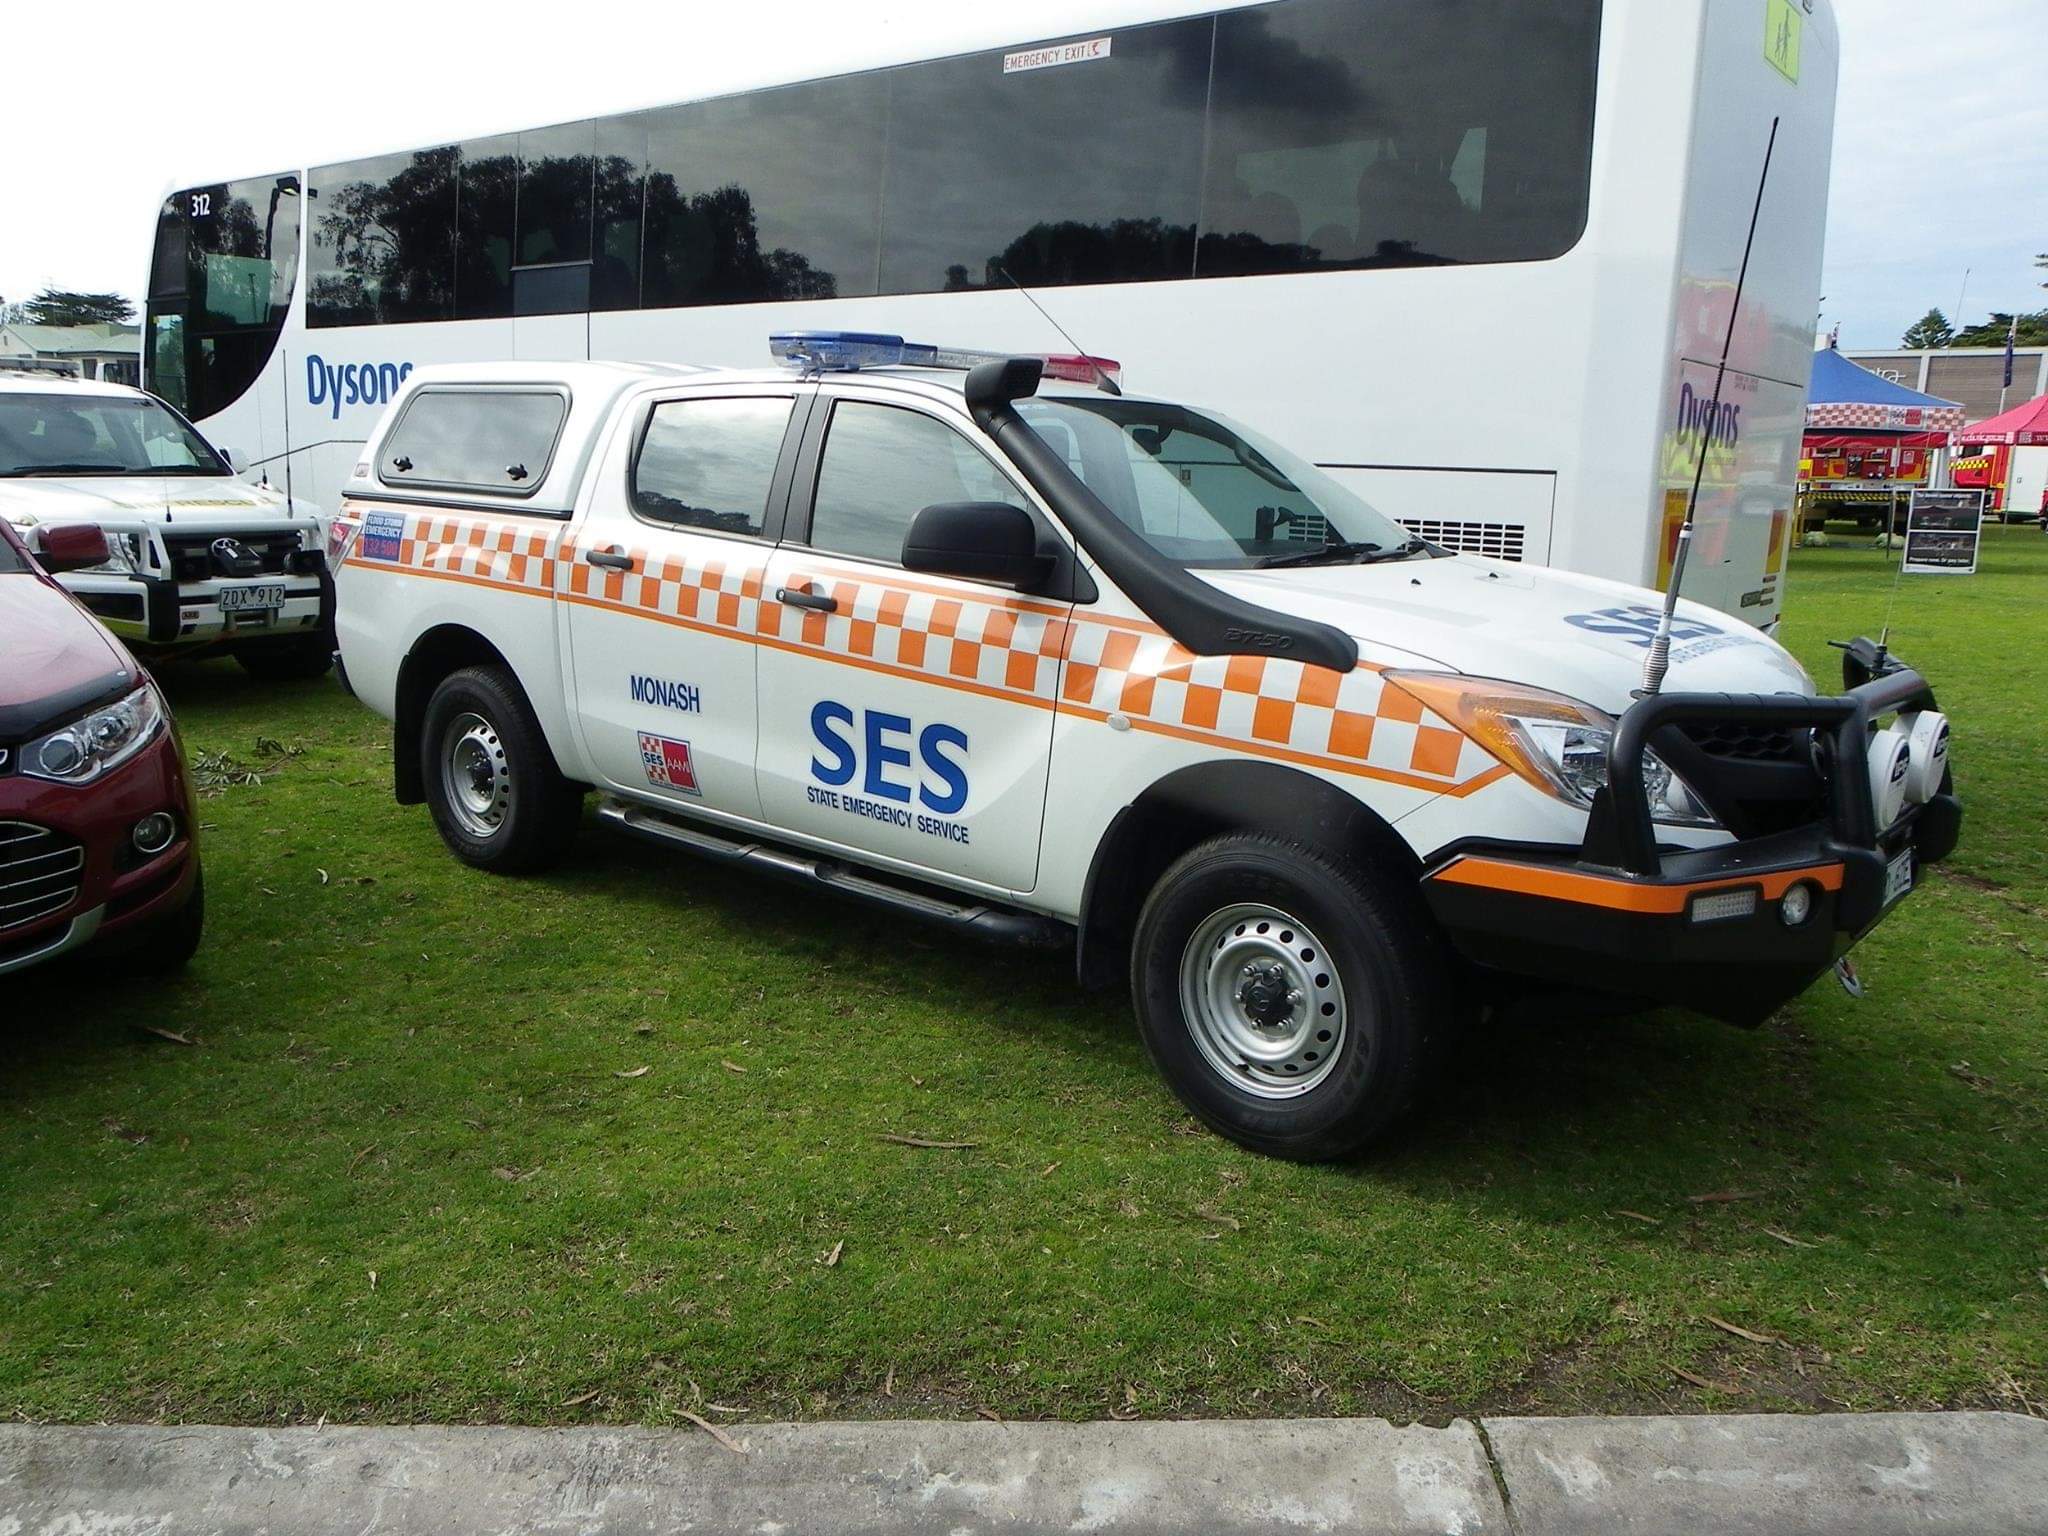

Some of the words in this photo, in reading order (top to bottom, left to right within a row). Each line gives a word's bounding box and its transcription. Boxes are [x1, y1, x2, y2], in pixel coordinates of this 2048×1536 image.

[1004, 49, 1060, 70] EMERGENCY
[1065, 45, 1085, 61] EXIT
[191, 193, 210, 217] 312
[365, 525, 403, 538] EMERGENCY
[223, 589, 247, 606] ZDX
[258, 587, 282, 603] 912
[631, 675, 700, 713] MONASH
[644, 752, 664, 766] SES
[809, 700, 969, 814] SES
[807, 786, 839, 809] STATE
[843, 796, 912, 828] EMERGENCY
[917, 816, 970, 844] SERVICE
